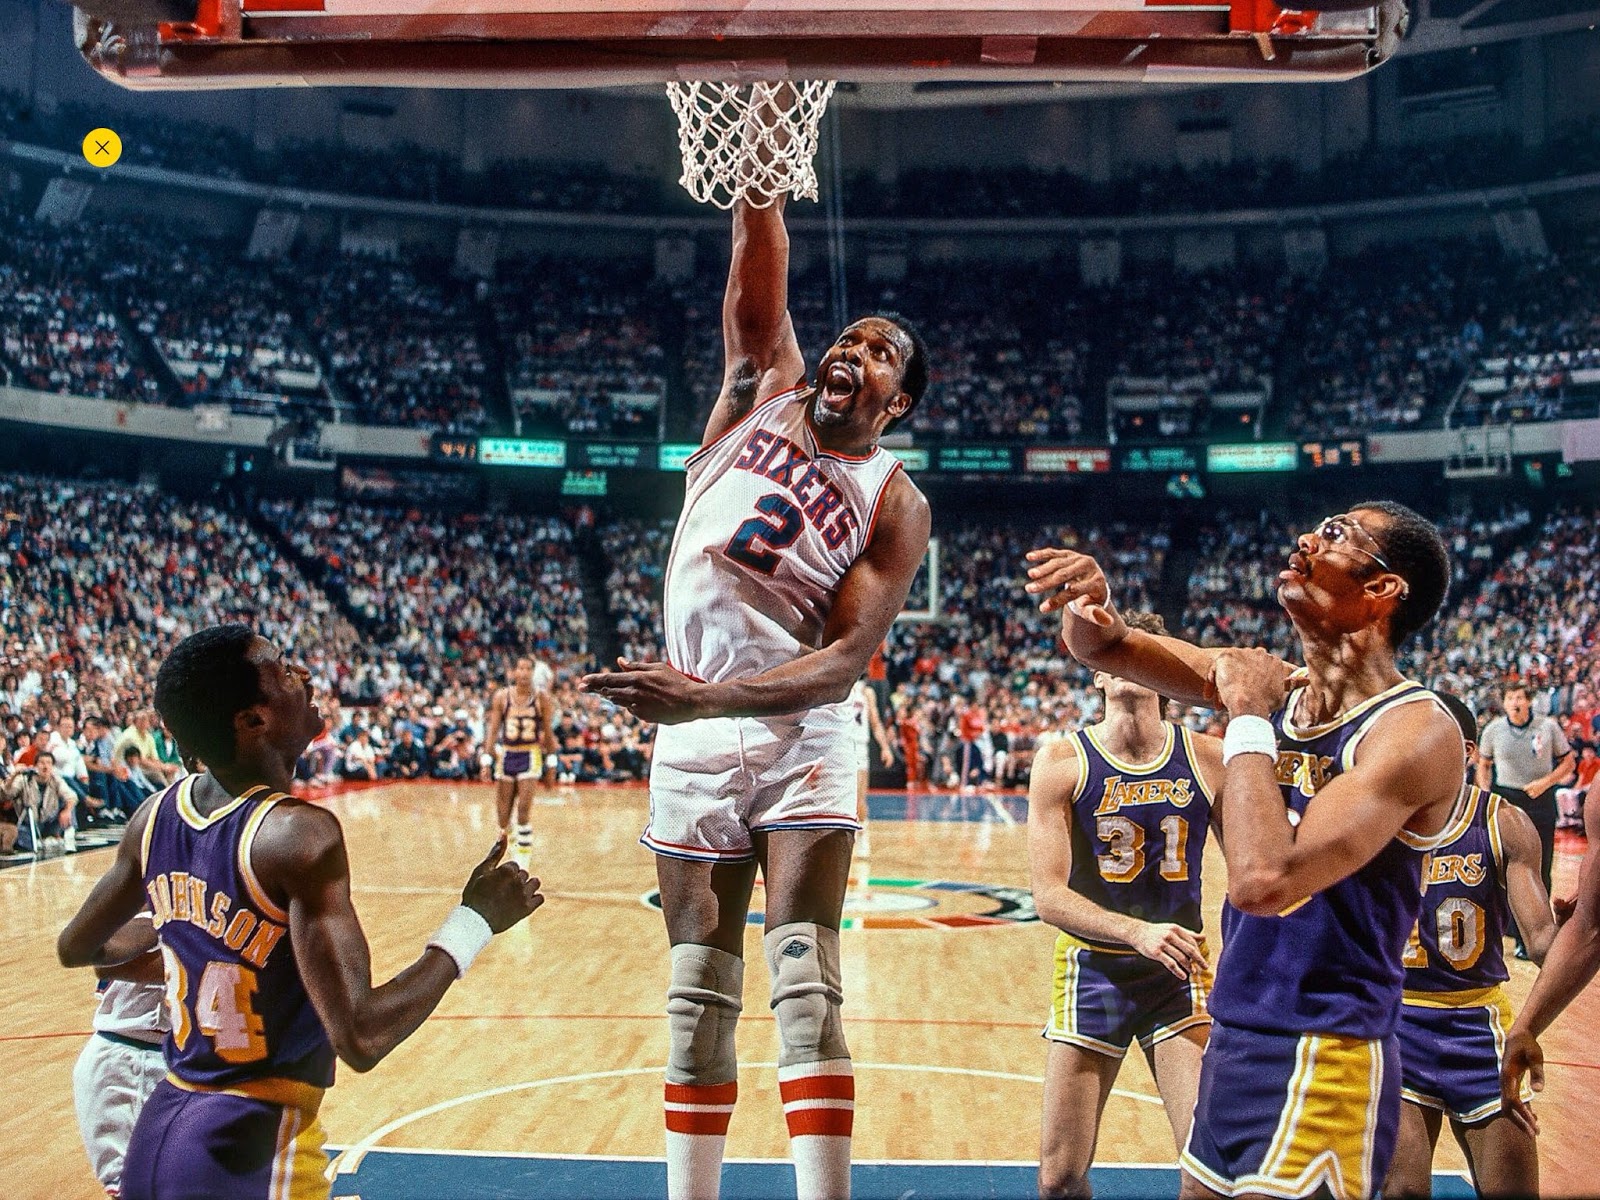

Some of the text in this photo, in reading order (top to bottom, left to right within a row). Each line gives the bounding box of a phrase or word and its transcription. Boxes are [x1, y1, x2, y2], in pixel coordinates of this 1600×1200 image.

[734, 428, 858, 551] SIXERS
[723, 493, 805, 577] 2
[1093, 775, 1194, 816] LAKERS
[1274, 750, 1334, 797] ERS
[1096, 815, 1189, 883] 31
[147, 871, 287, 969] JOHNSON
